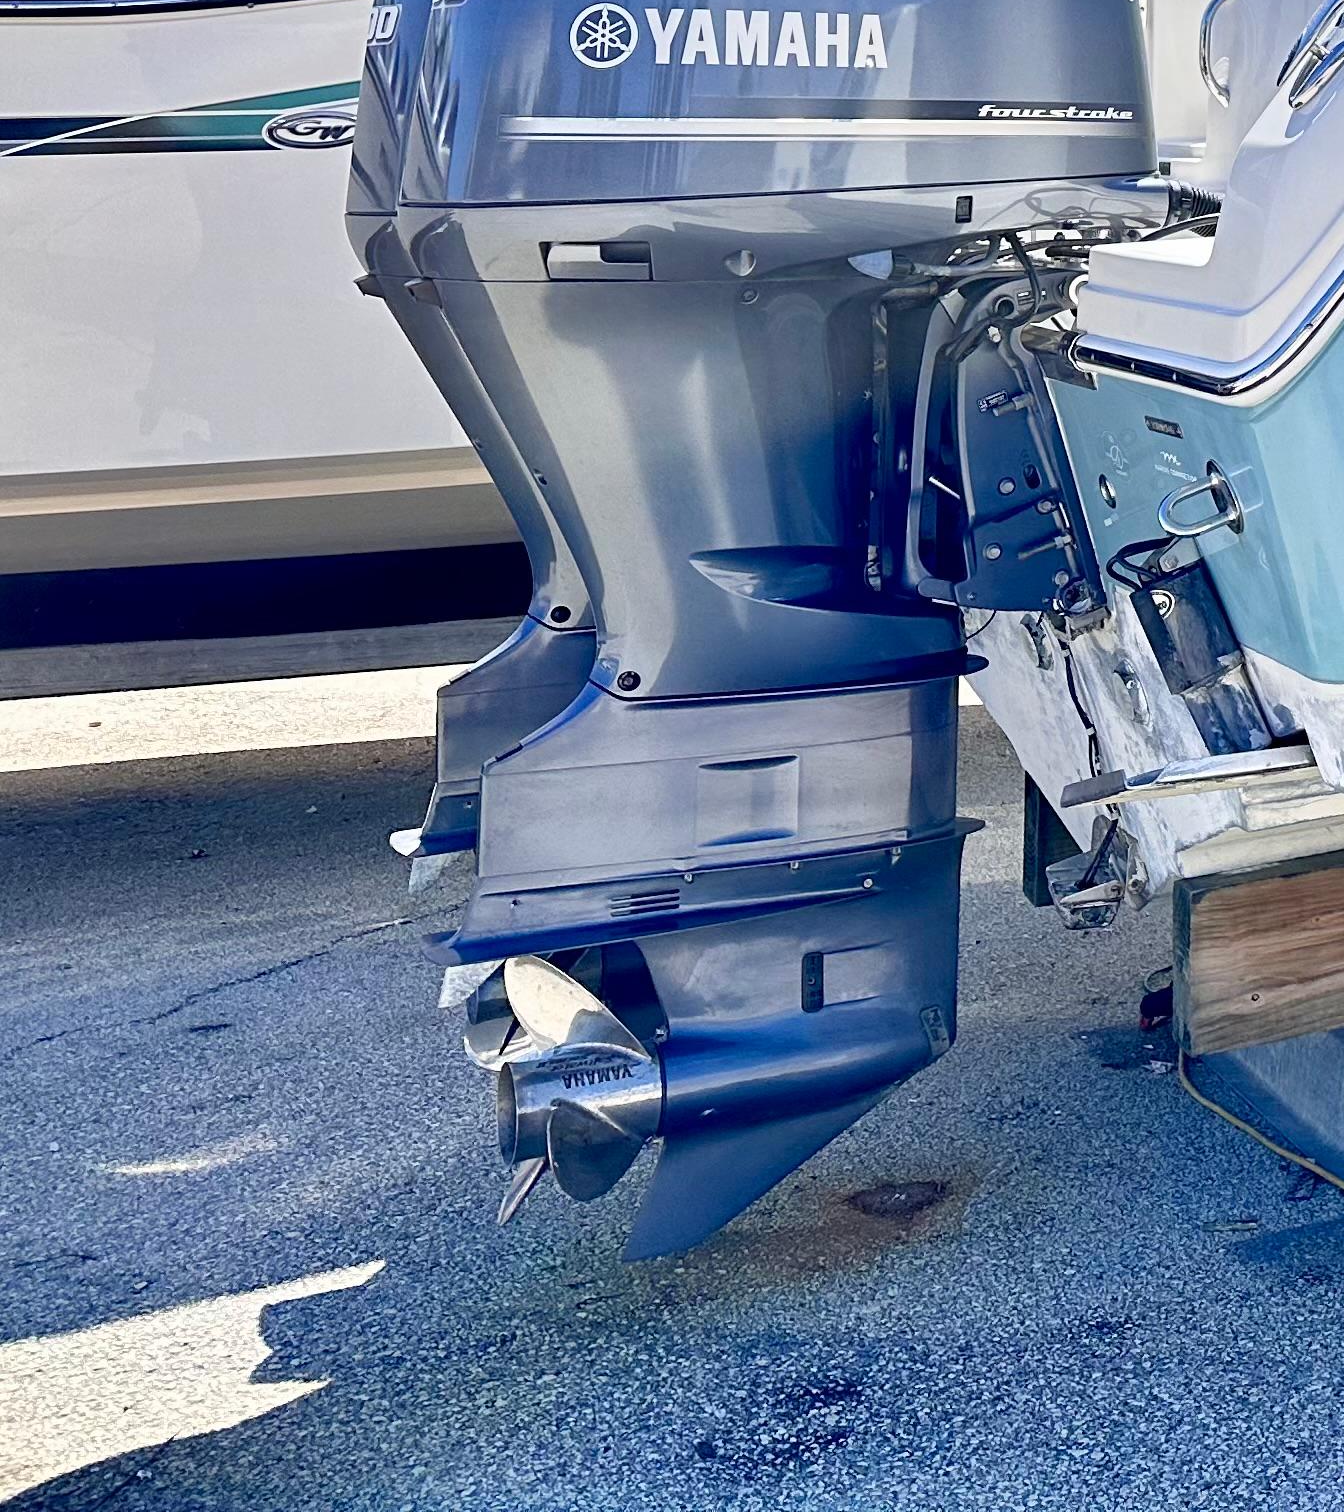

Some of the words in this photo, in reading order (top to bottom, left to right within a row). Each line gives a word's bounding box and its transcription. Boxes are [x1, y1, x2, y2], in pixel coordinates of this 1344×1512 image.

[644, 7, 889, 69] YAMAHA
[978, 104, 1133, 120] fourstroke
[562, 1064, 633, 1089] YAMAHA
